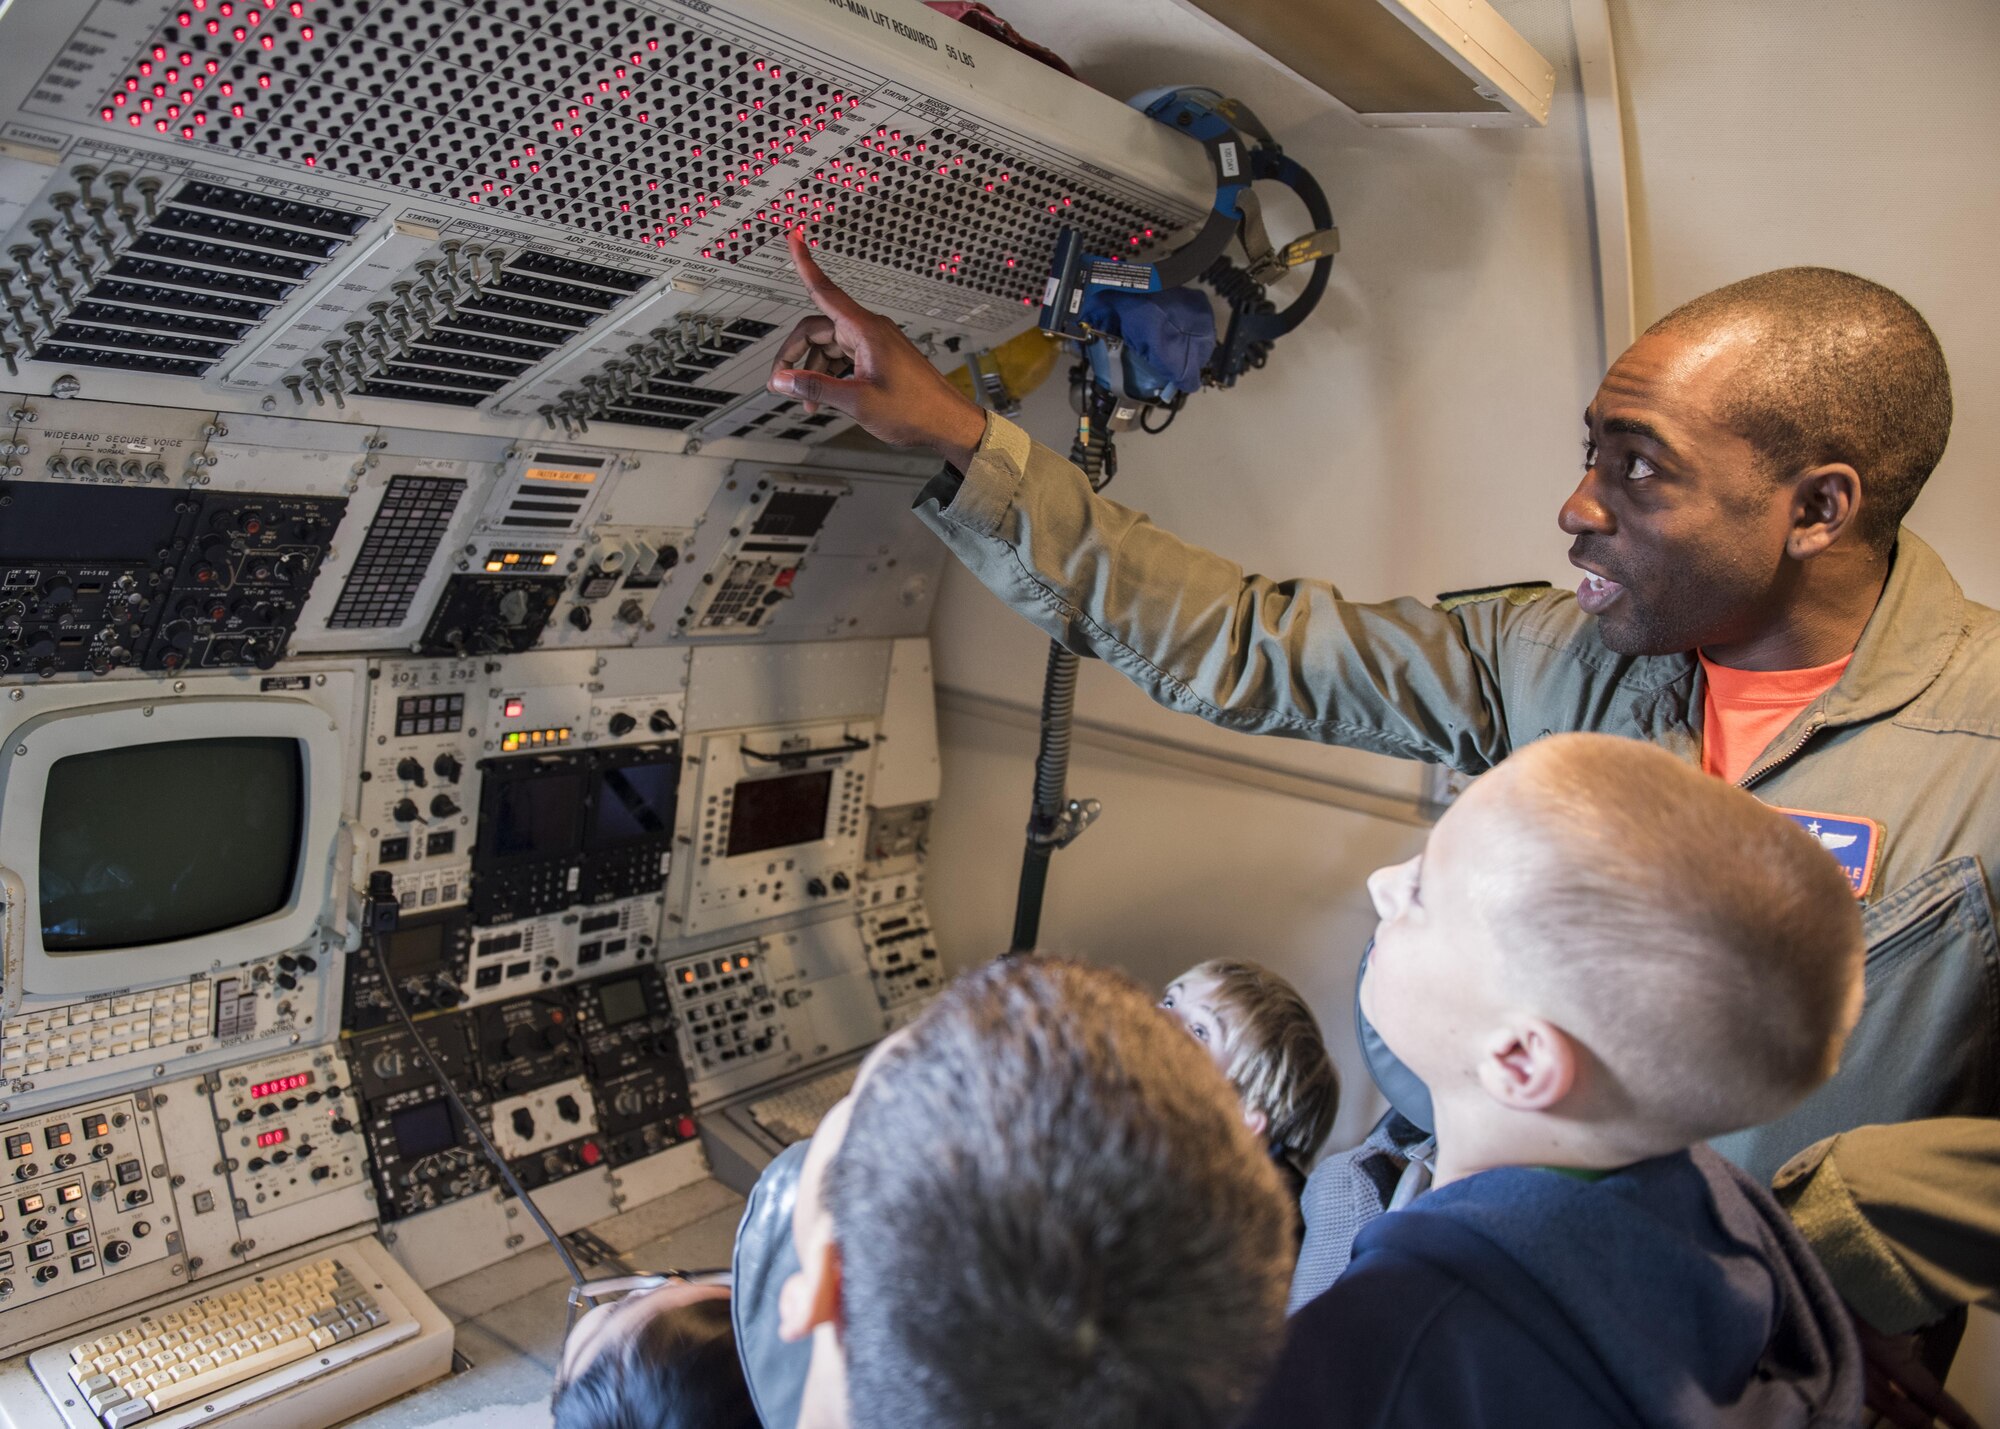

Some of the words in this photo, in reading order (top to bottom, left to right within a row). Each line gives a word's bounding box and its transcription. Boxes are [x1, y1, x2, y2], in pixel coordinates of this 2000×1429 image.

[825, 0, 869, 20] O-MAN
[870, 9, 891, 30] LIFT
[893, 18, 938, 51] REQUIRED
[945, 44, 958, 59] 55
[958, 50, 976, 69] LBS
[882, 88, 910, 103] STATION
[915, 101, 947, 118] INTERCOM
[925, 98, 951, 112] MISSION
[958, 119, 980, 131] GUARD
[10, 128, 61, 145] STATION
[82, 139, 130, 155] MISSION
[133, 150, 190, 166] INTERCOM
[1227, 159, 1235, 171] DAY
[186, 168, 225, 183] GUARD
[255, 176, 293, 190] DIRECT
[294, 183, 331, 197] ACCESS
[406, 212, 442, 225] STATION
[456, 220, 490, 232] MISSION
[490, 227, 532, 241] INTERCOM
[526, 242, 554, 253] GUARD
[577, 246, 604, 257] DIRECT
[603, 252, 631, 262] ACCESS
[563, 235, 586, 244] ADS
[590, 240, 660, 261] PROGRAMMING
[660, 256, 681, 266] AND
[682, 261, 720, 275] DISPLAY
[755, 252, 769, 260] LINK
[770, 255, 787, 263] TYPE
[736, 263, 774, 275] TRANSCEIVER
[681, 273, 707, 282] STATION
[719, 278, 745, 288] MISSION
[44, 430, 100, 442] WIDEBAND
[105, 434, 149, 445] SECURE
[153, 438, 183, 448] VOICE
[97, 448, 126, 456] NORMAL
[436, 461, 454, 469] BITE
[102, 477, 125, 485] DELAY
[536, 470, 559, 480] FASTEN
[558, 471, 574, 481] SEAT
[573, 472, 588, 482] BELT
[489, 541, 518, 549] COOLING
[220, 1033, 255, 1049] DISPLAY
[260, 1024, 296, 1039] CONTROL
[252, 1073, 307, 1099] 280500
[20, 1119, 42, 1131] DIRECT
[45, 1113, 71, 1124] ACCESS
[258, 1130, 284, 1147] 100
[14, 1183, 40, 1193] INTERCOM
[17, 1188, 39, 1198] MISSION
[100, 1227, 120, 1237] MASTER
[52, 1252, 68, 1261] MAINT
